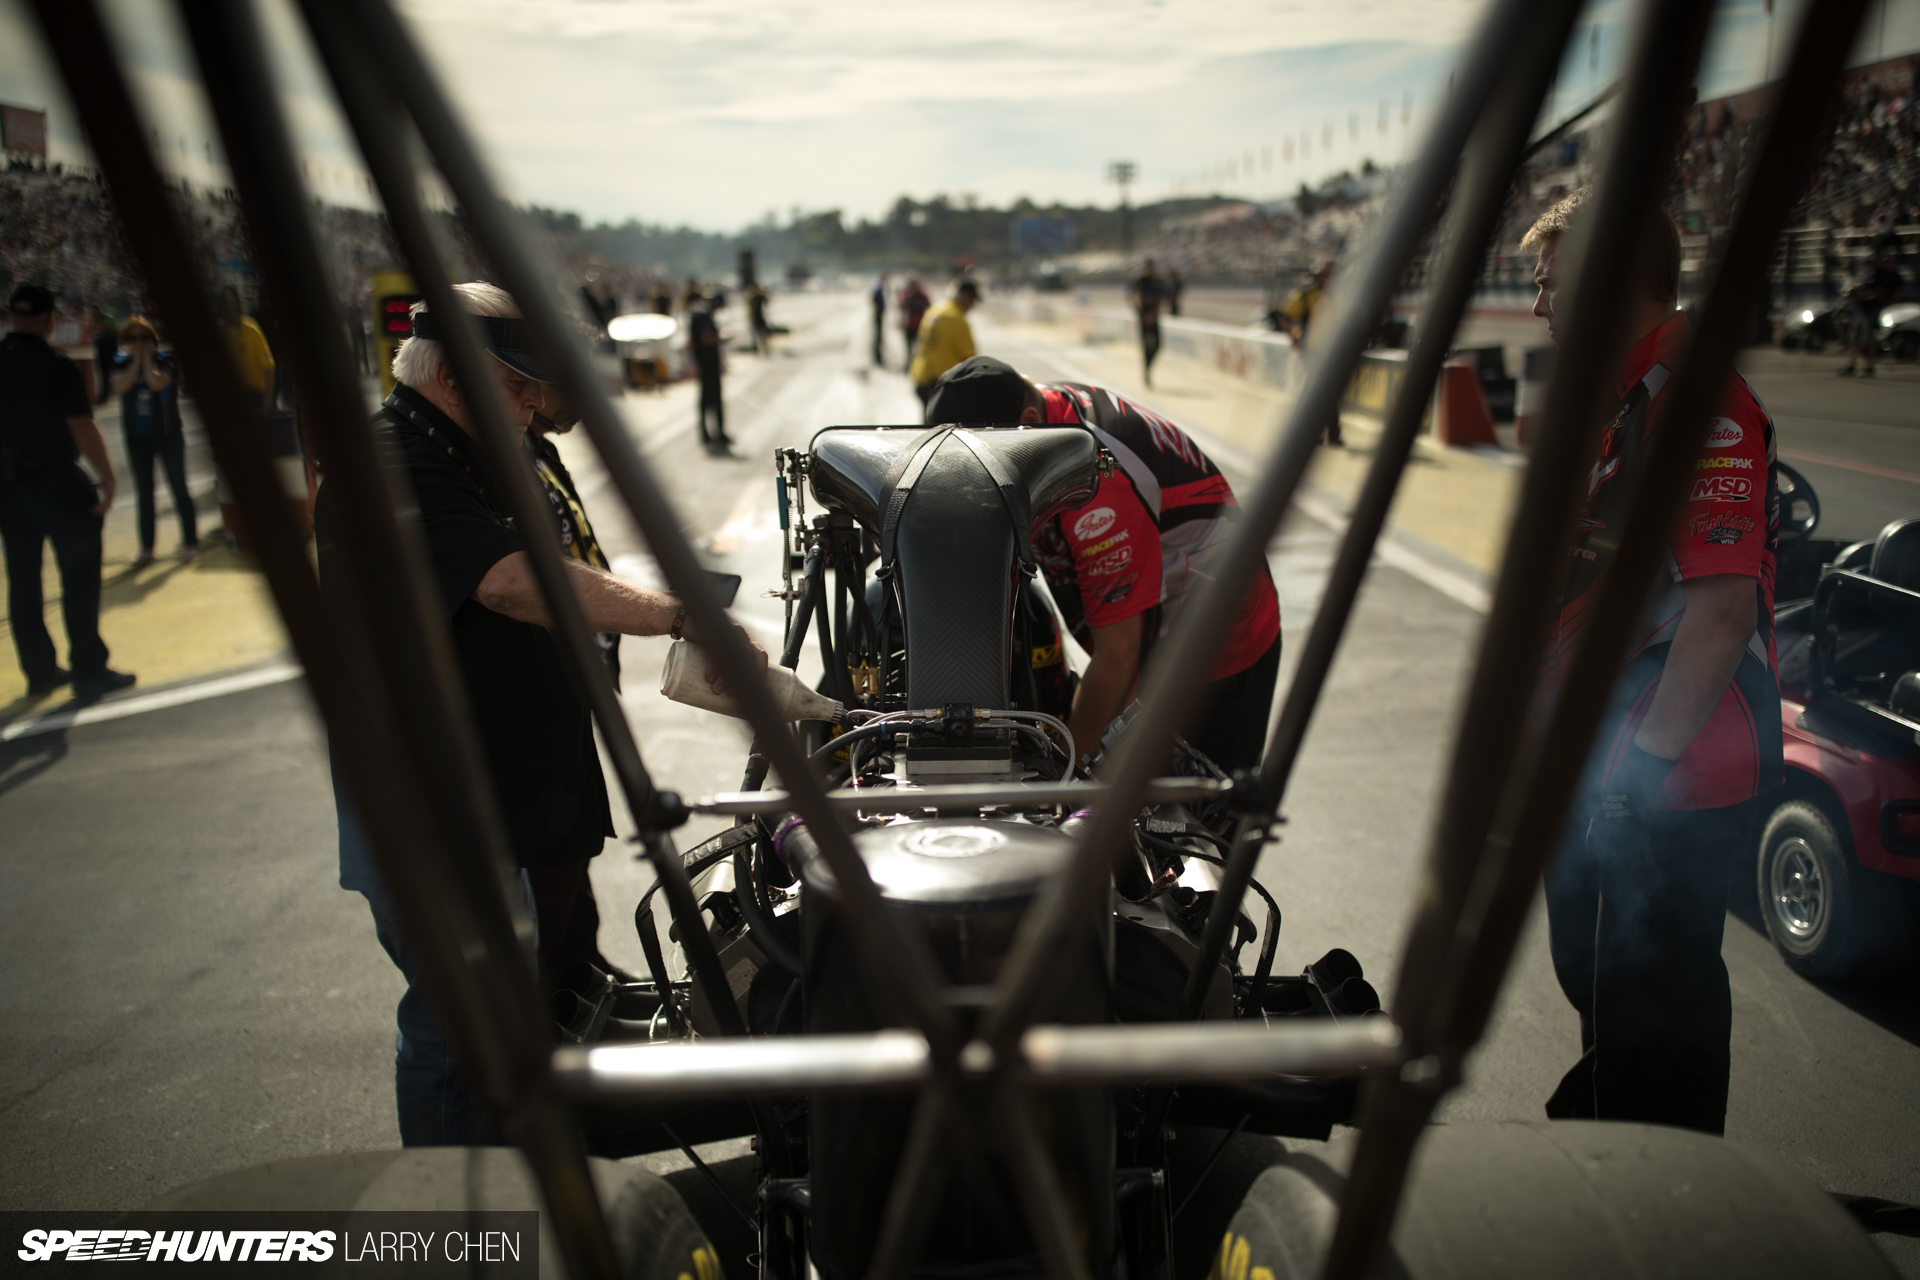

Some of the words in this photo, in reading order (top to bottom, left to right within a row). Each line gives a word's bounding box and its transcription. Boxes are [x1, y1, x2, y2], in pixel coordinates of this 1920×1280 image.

[1698, 457, 1753, 470] RACEPAK
[1690, 477, 1752, 499] MSD
[1689, 512, 1724, 537] Fast
[1721, 510, 1756, 533] Eddie
[1086, 528, 1130, 556] RACEPAK
[1088, 546, 1133, 575] MSD
